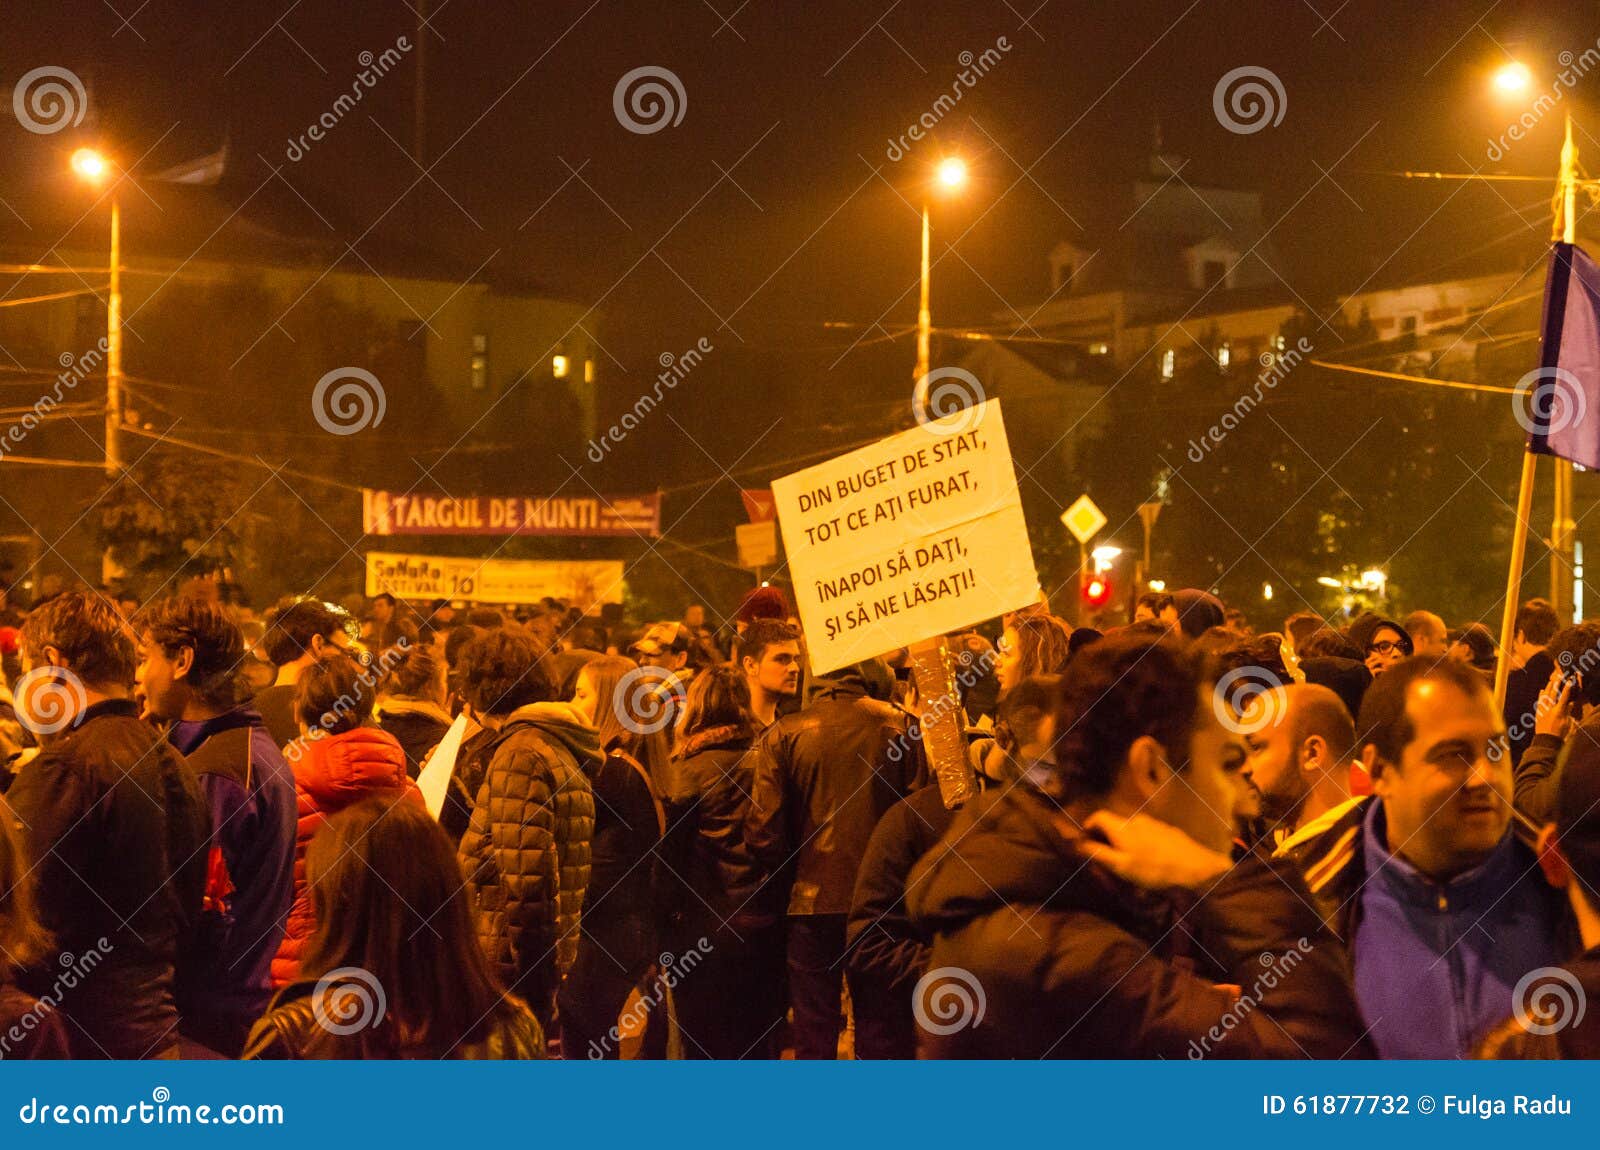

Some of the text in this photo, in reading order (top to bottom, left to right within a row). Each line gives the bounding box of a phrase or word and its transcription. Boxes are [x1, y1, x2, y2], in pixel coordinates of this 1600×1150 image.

[797, 429, 988, 513] DIN BUGET DE STAT,
[489, 498, 518, 529] DE
[804, 517, 841, 546] TOT
[846, 508, 869, 531] CE
[907, 470, 979, 509] FURAT,
[815, 563, 883, 604] ÎNAPOI
[886, 549, 912, 579] SĂ
[845, 601, 871, 630] SĂ
[873, 595, 900, 620] NE
